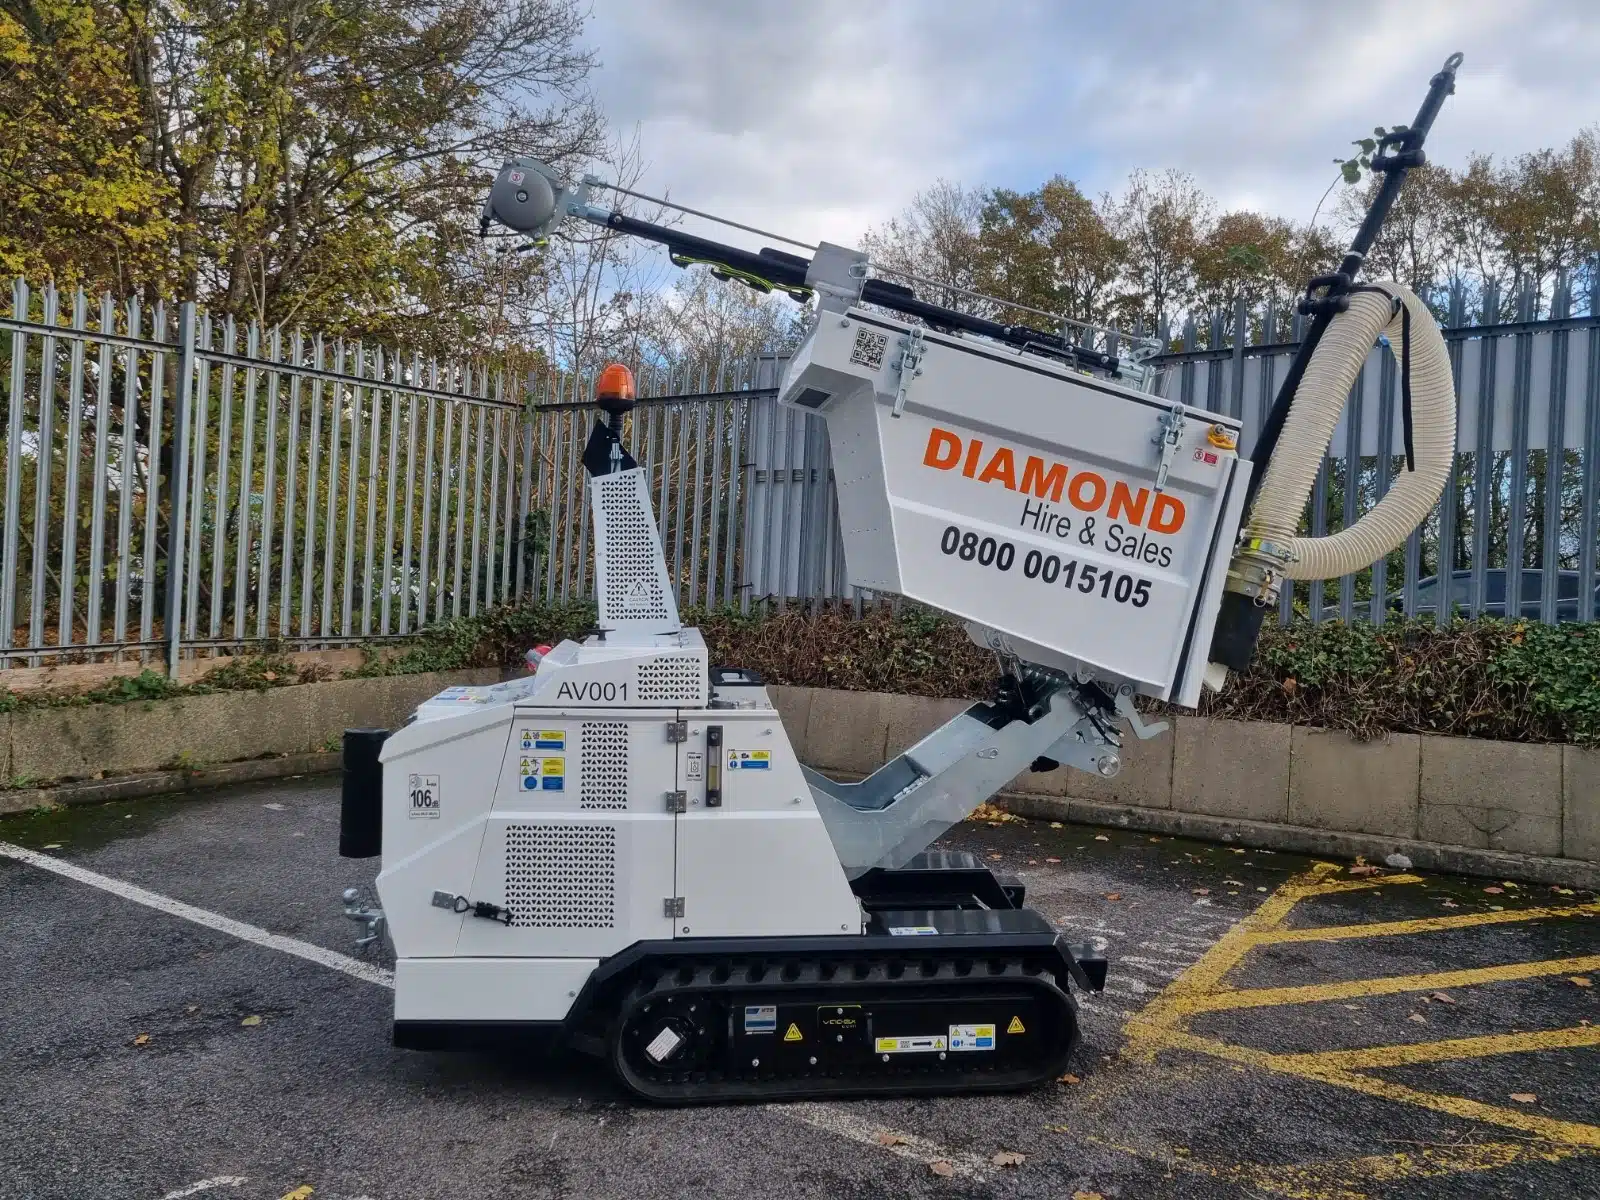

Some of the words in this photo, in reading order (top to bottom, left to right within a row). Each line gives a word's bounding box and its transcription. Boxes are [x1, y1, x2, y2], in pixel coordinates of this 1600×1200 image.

[923, 428, 1186, 535] DIAMOND
[940, 526, 1015, 571] 0800
[1023, 550, 1152, 608] 0015105
[1020, 499, 1071, 539] Hire
[1078, 517, 1096, 546] &
[1105, 524, 1173, 568] Sales
[557, 682, 627, 701] AV001
[411, 789, 432, 808] 106
